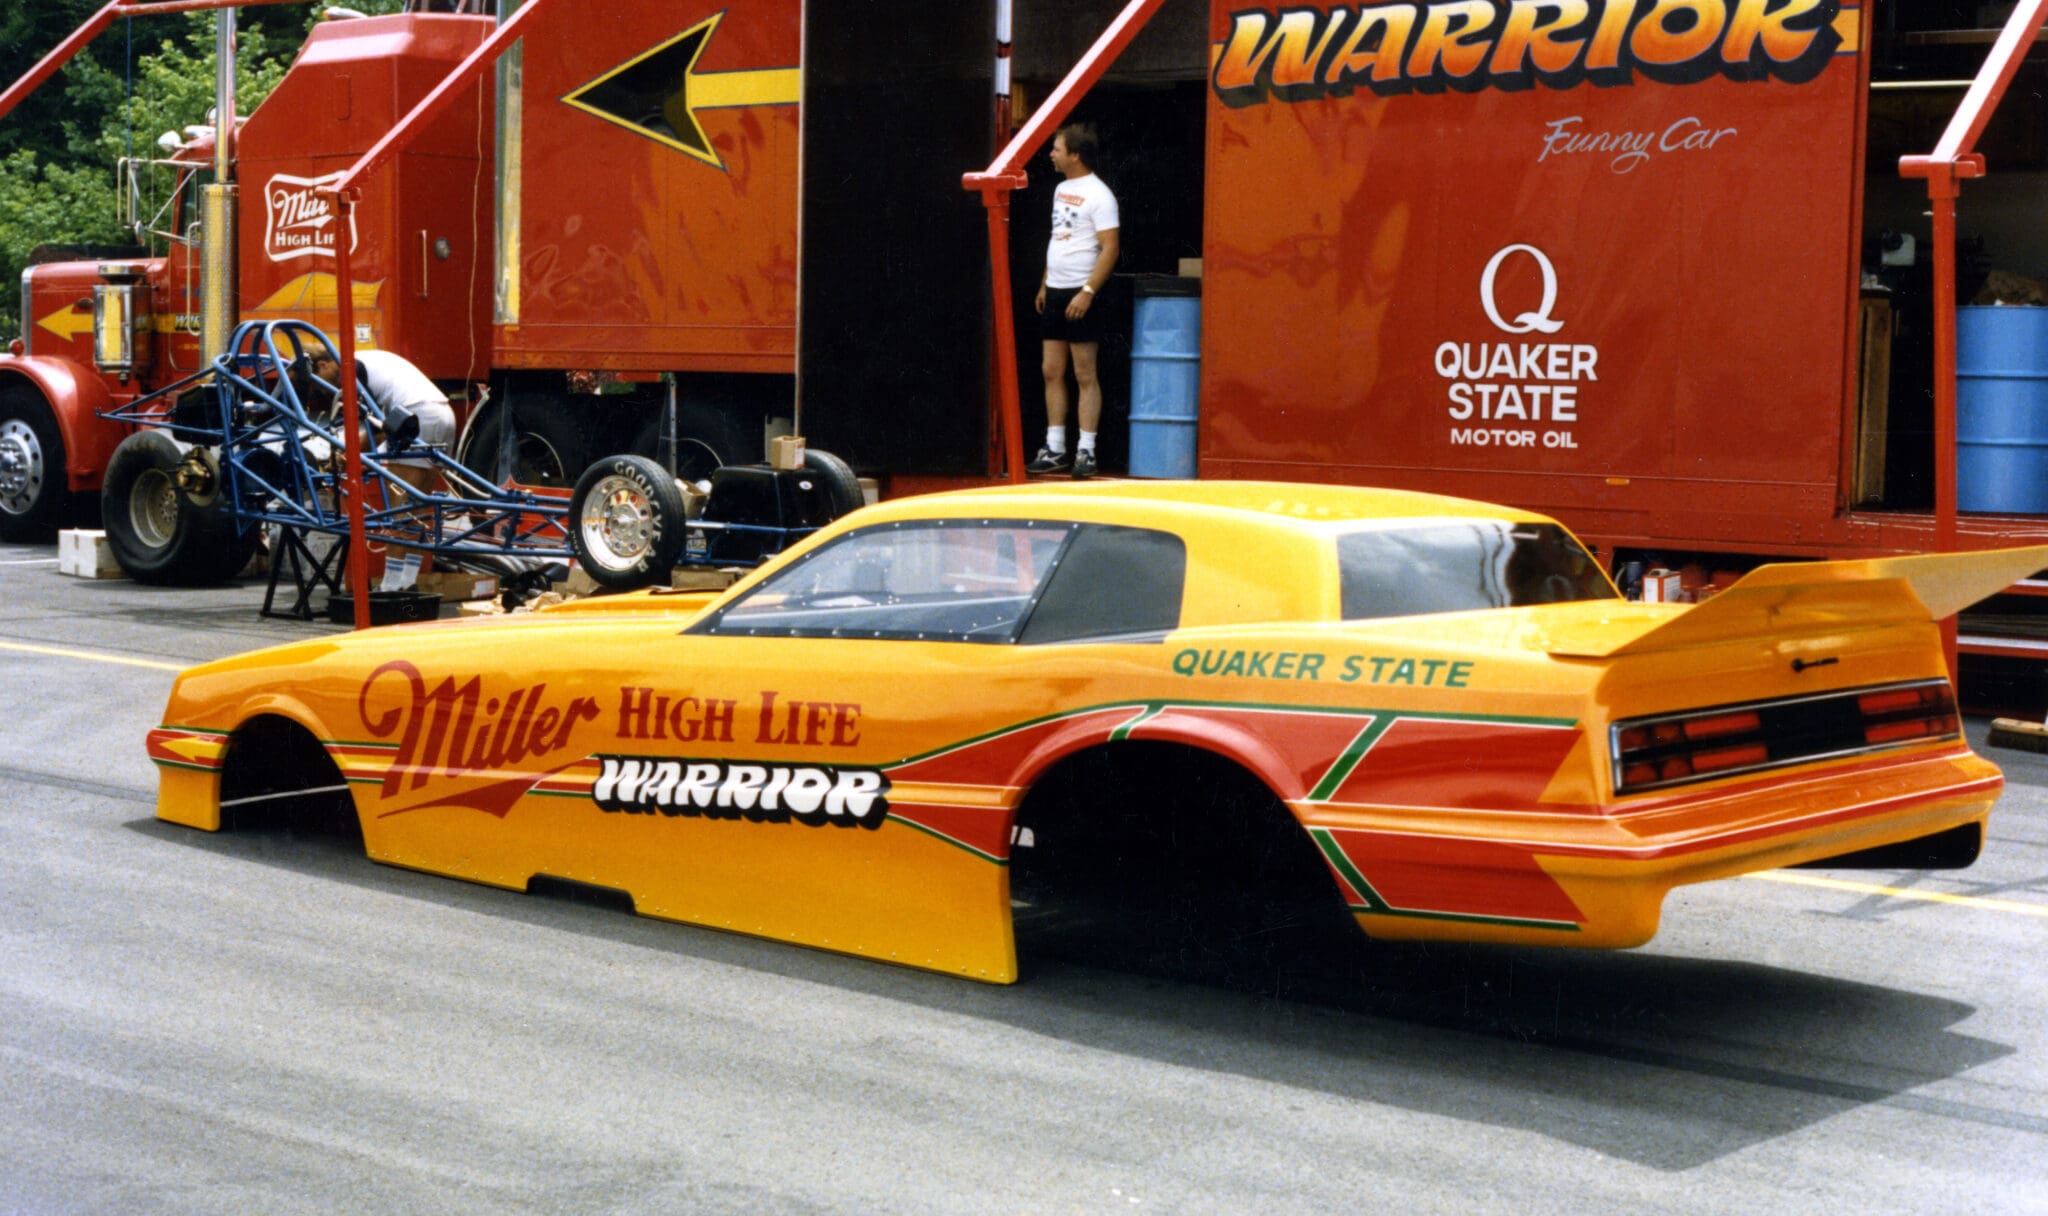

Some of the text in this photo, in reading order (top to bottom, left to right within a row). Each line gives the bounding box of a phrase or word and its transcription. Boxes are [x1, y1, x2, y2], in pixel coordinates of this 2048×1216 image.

[1215, 0, 1832, 100] WARRIOR
[1537, 116, 1738, 175] Funny Car
[272, 188, 331, 229] Mill
[314, 229, 336, 246] LIF
[1480, 243, 1565, 334] Q
[1434, 341, 1598, 381] QUAKER
[1448, 382, 1578, 421] STATE
[1450, 428, 1578, 449] MOTOR OIL
[614, 461, 663, 573] GOODYEAR
[1172, 648, 1474, 688] QUAKER STATE
[359, 659, 862, 801] Miller HIGH LIFE
[592, 755, 889, 824] WARRIOR
